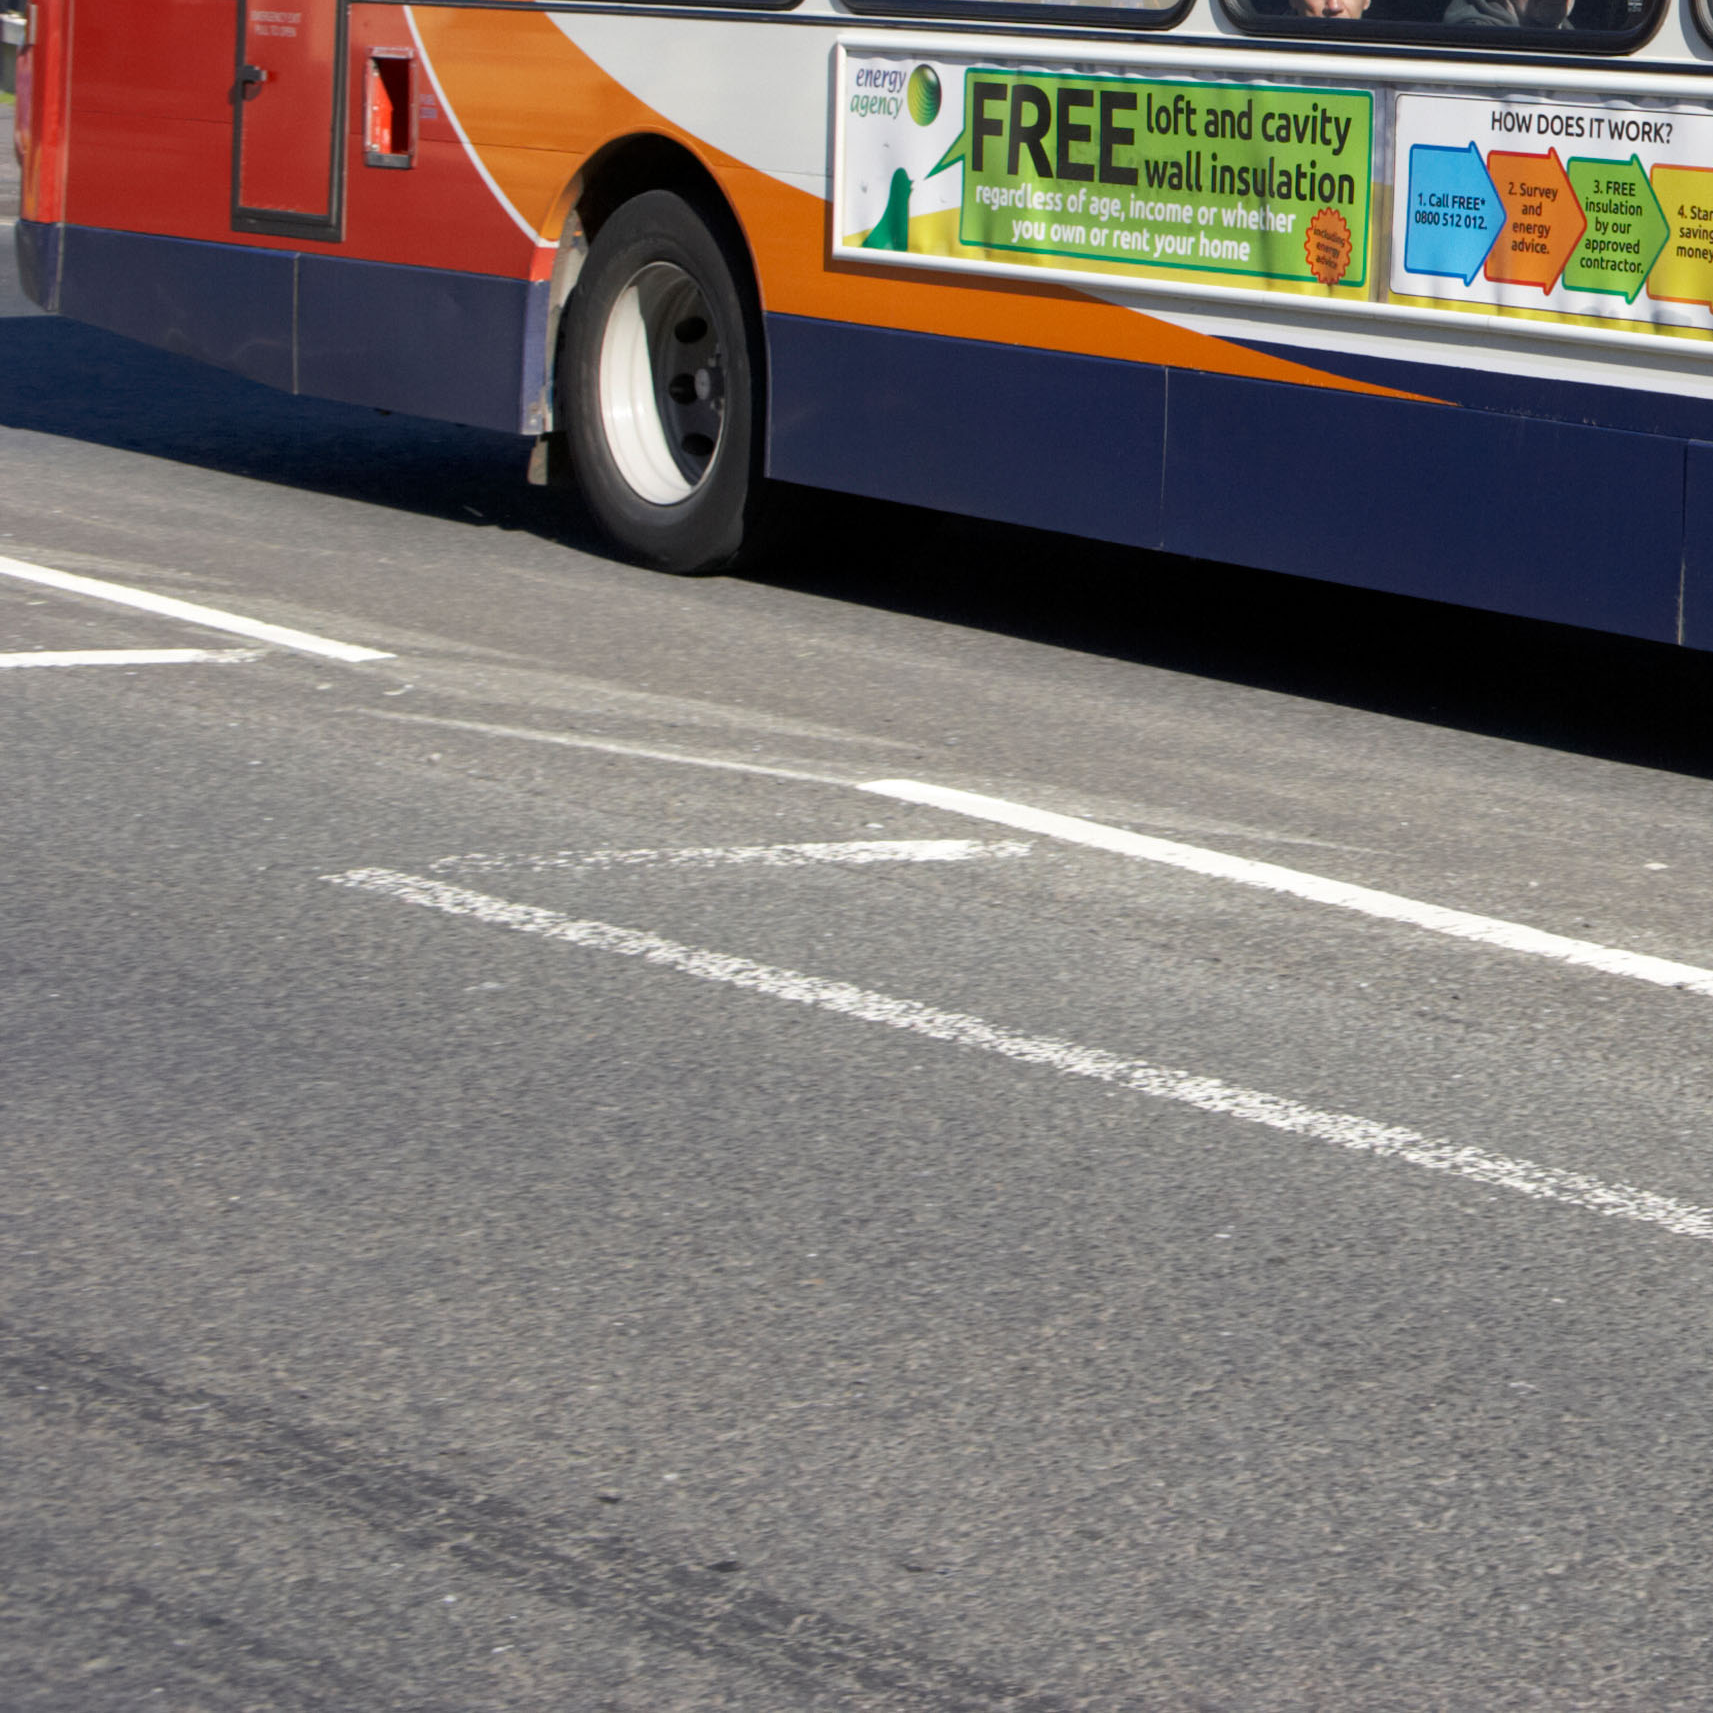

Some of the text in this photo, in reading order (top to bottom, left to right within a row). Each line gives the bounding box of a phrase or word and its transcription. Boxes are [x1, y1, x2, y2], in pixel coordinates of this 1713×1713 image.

[856, 68, 906, 93] energy
[850, 94, 903, 120] agency
[972, 82, 1138, 185] FREE
[1147, 92, 1352, 156] loft and cavity
[1491, 111, 1673, 144] HOW DOES IT WORK?
[1145, 150, 1354, 204] wall insulation
[1508, 182, 1558, 202] 2. Survey
[1593, 179, 1636, 196] 3. FREE
[976, 182, 1296, 233] regardless of age, income or whether
[1418, 193, 1426, 206] 1.
[1428, 193, 1450, 208] Call
[1522, 202, 1542, 216] and
[1585, 197, 1642, 216] insulation
[1415, 211, 1487, 230] 0800 512 012.
[1677, 204, 1687, 219] 4.
[1512, 221, 1551, 238] energy
[1595, 217, 1632, 235] by our
[1012, 219, 1250, 261] you own or rent your home
[1511, 238, 1550, 254] advice.
[1585, 238, 1640, 255] approved
[1580, 255, 1644, 274] contractor.
